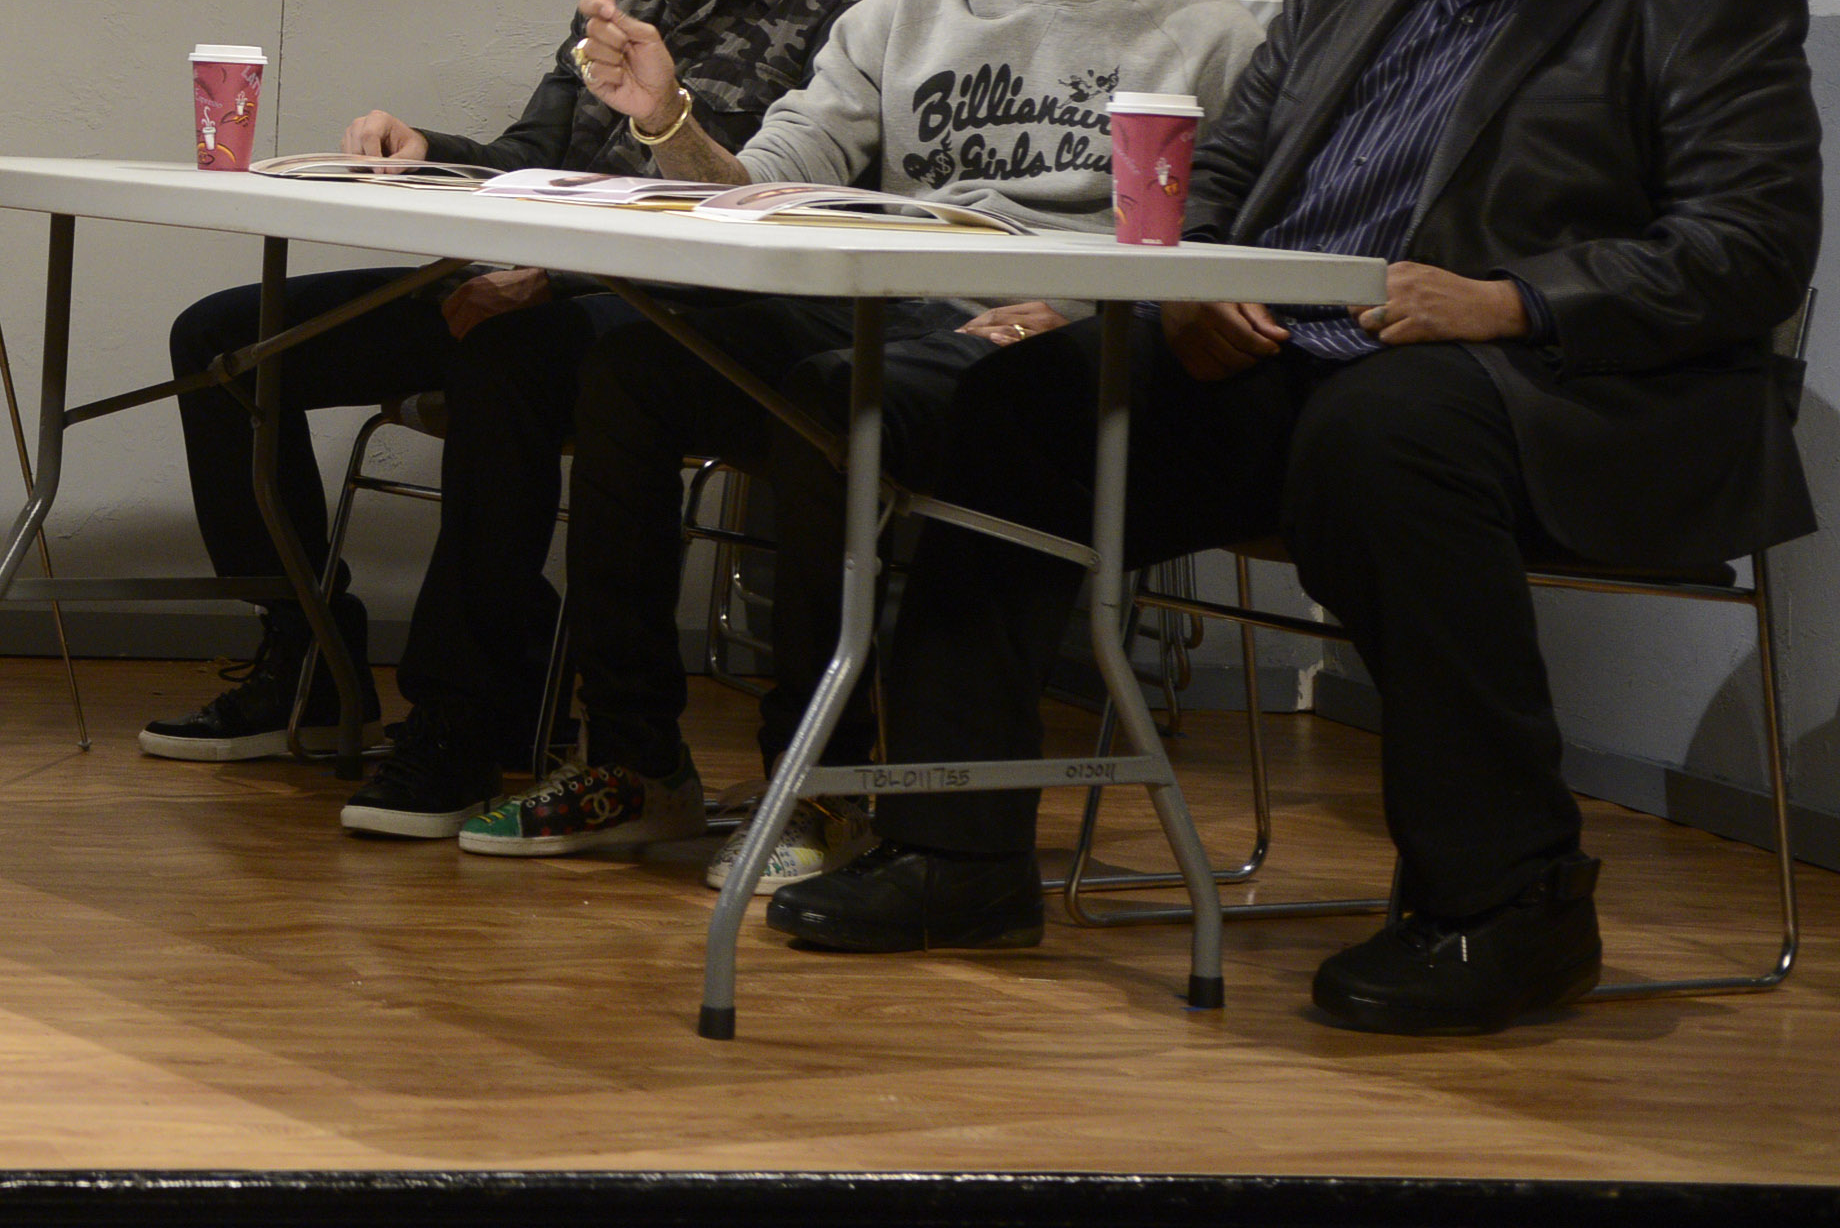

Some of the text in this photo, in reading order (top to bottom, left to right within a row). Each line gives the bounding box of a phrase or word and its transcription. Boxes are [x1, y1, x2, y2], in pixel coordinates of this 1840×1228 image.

[912, 63, 1111, 143] Billionair
[957, 131, 1052, 180] Girls
[1055, 131, 1112, 174] Clu
